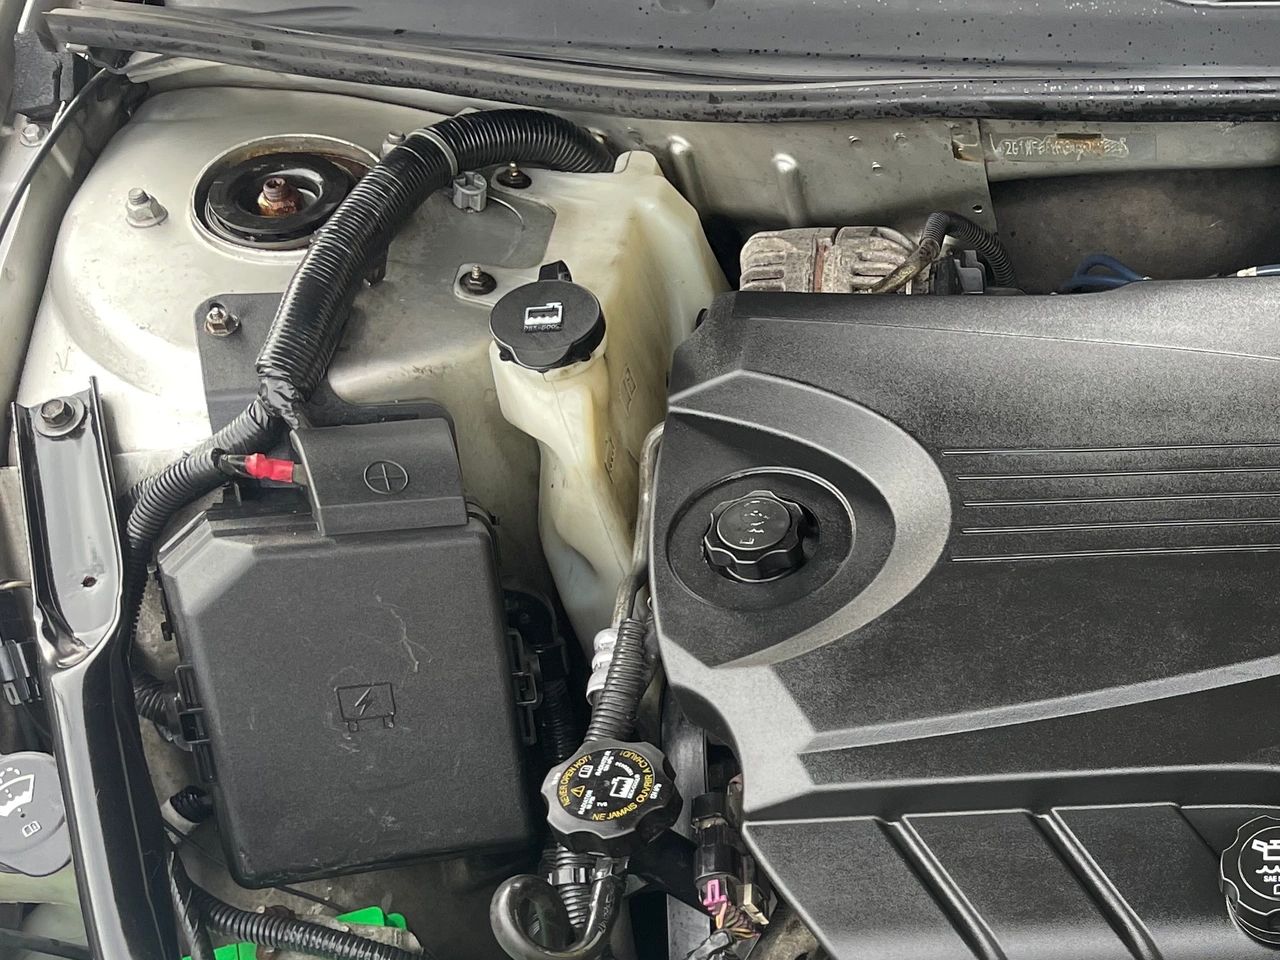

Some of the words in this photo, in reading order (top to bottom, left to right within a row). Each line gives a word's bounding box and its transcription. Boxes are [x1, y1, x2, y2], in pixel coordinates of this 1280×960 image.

[574, 754, 592, 769] HOT!
[560, 766, 575, 786] OPEN
[558, 783, 571, 807] NEVER
[592, 812, 606, 821] NE
[606, 802, 638, 820] JAMAIS
[636, 773, 654, 803] OUVRIR
[1263, 875, 1277, 883] SAE
